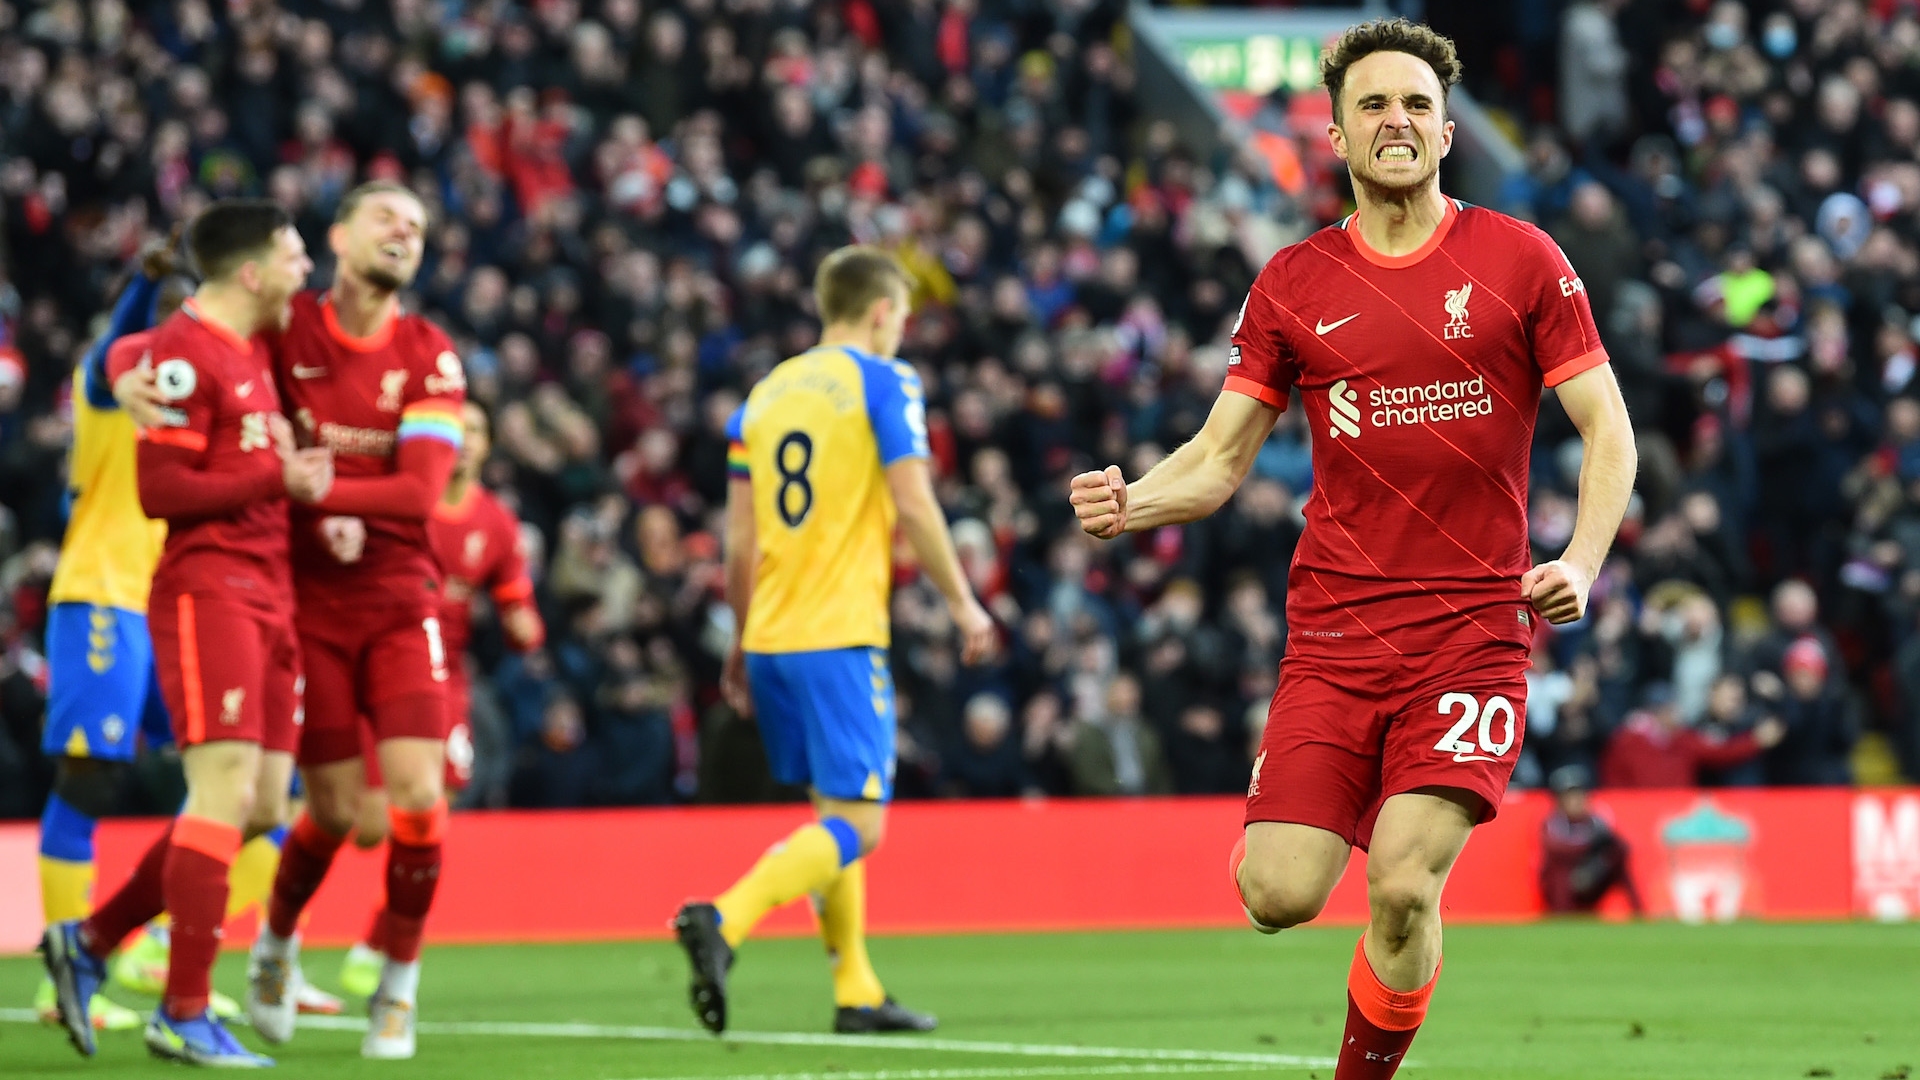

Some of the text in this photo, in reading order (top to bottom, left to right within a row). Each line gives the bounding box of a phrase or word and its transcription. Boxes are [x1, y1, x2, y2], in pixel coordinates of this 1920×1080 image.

[1369, 375, 1484, 407] standard
[1371, 394, 1493, 427] chartered
[777, 430, 813, 528] 8
[1433, 691, 1516, 757] 20
